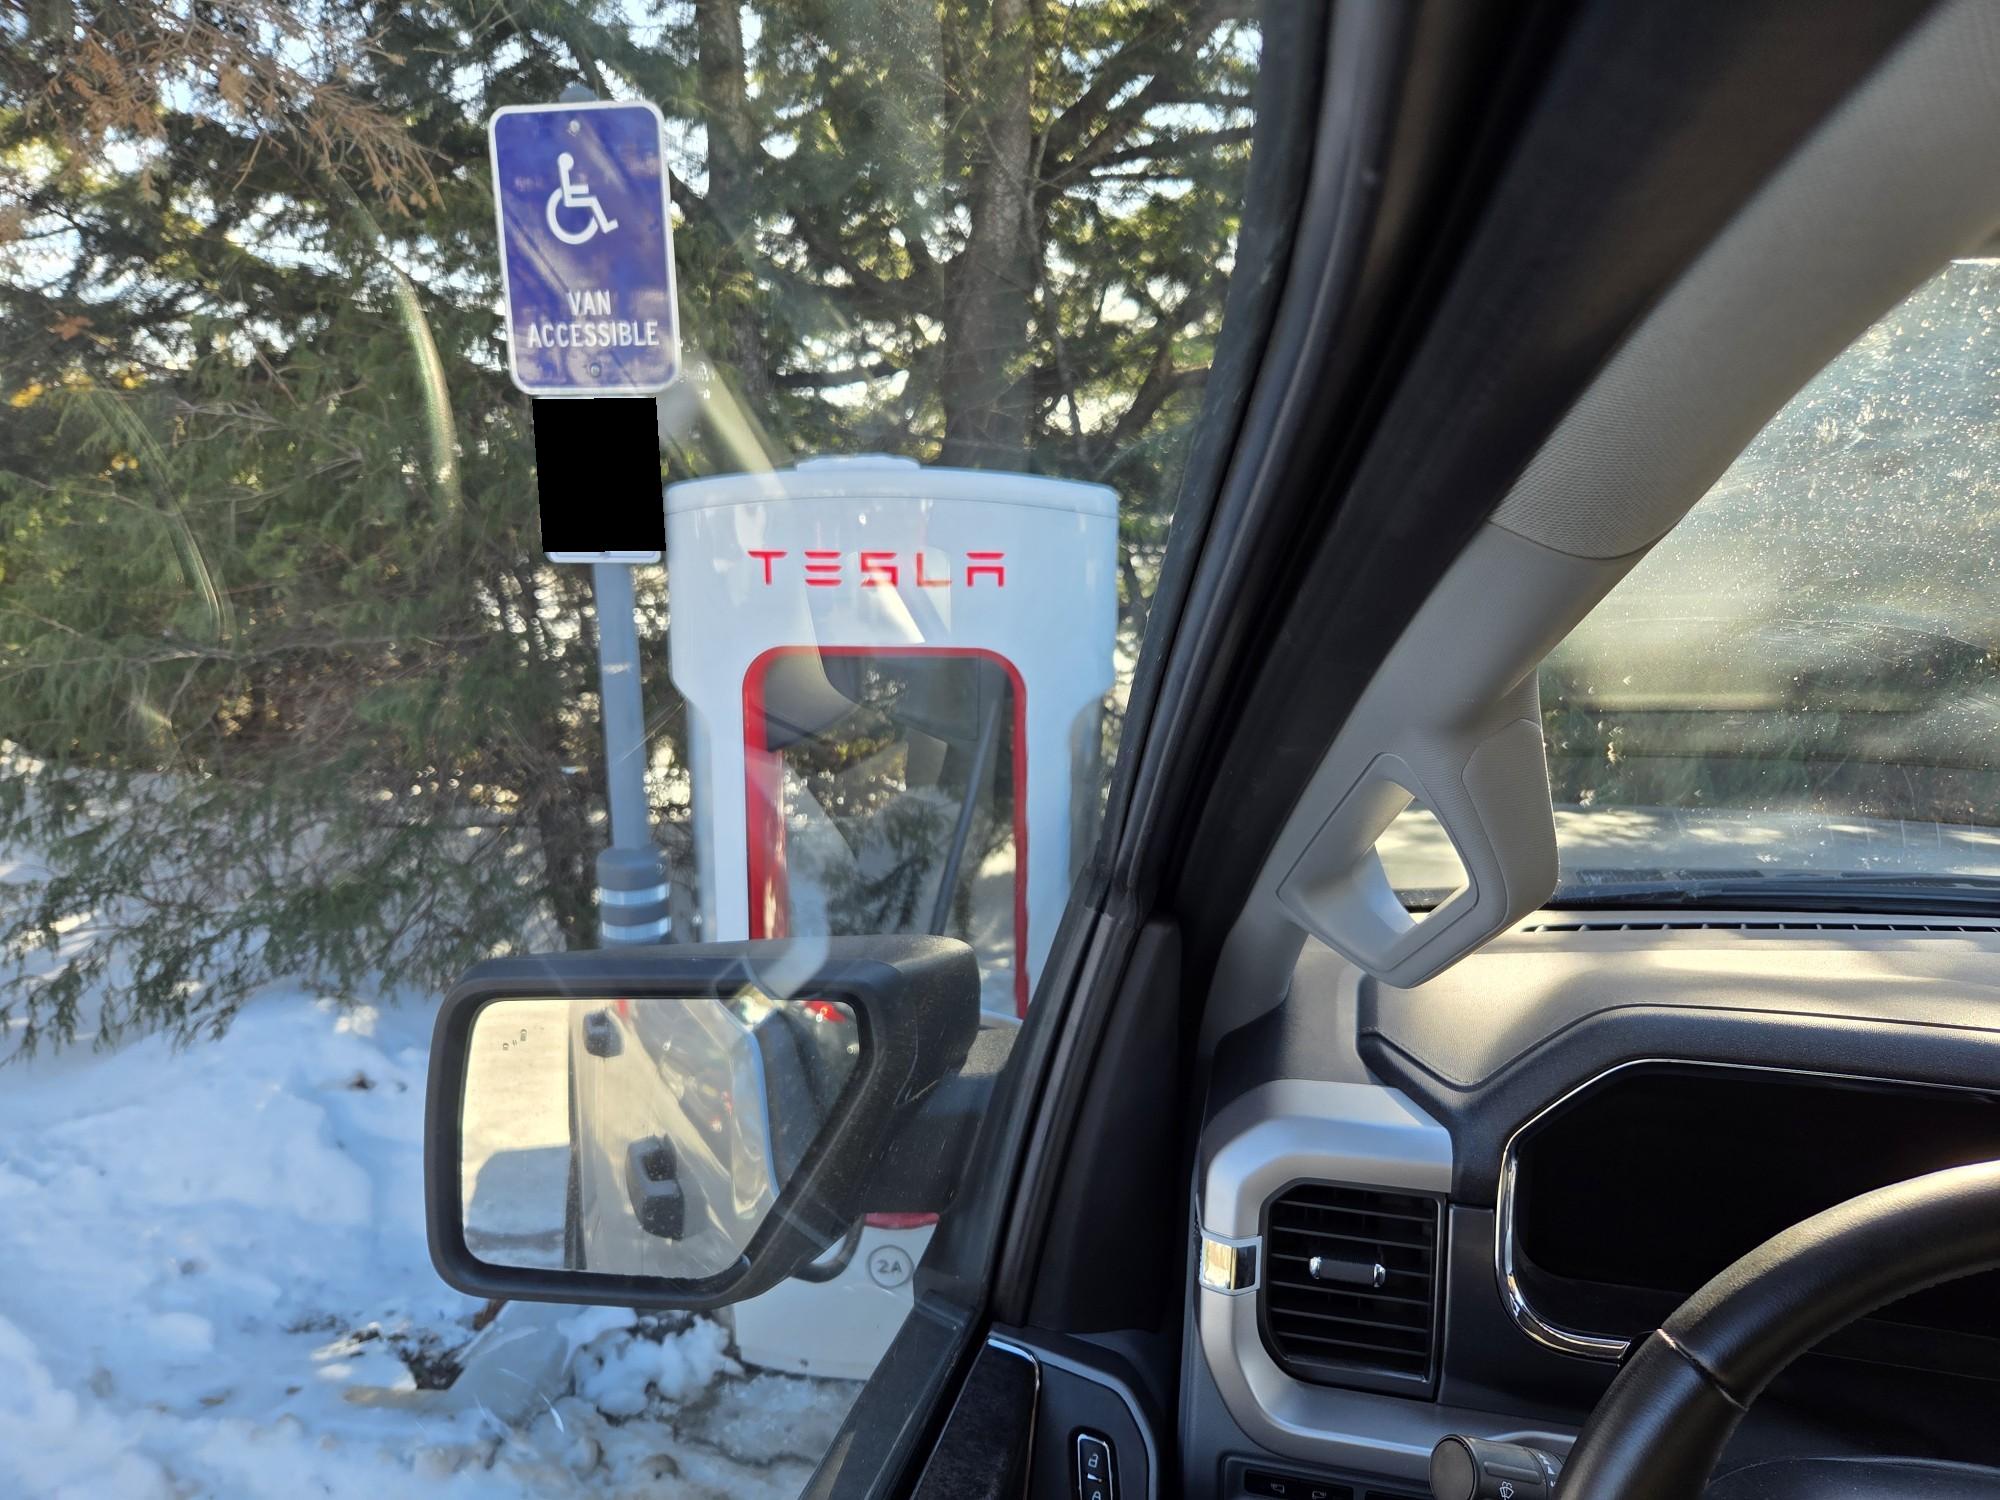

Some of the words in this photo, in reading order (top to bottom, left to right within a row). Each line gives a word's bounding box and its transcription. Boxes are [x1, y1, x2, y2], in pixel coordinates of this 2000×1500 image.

[566, 291, 612, 316] VAN
[527, 320, 660, 349] ACCESSIBLE
[747, 550, 1006, 587] TESLA
[877, 1259, 903, 1274] 2A
